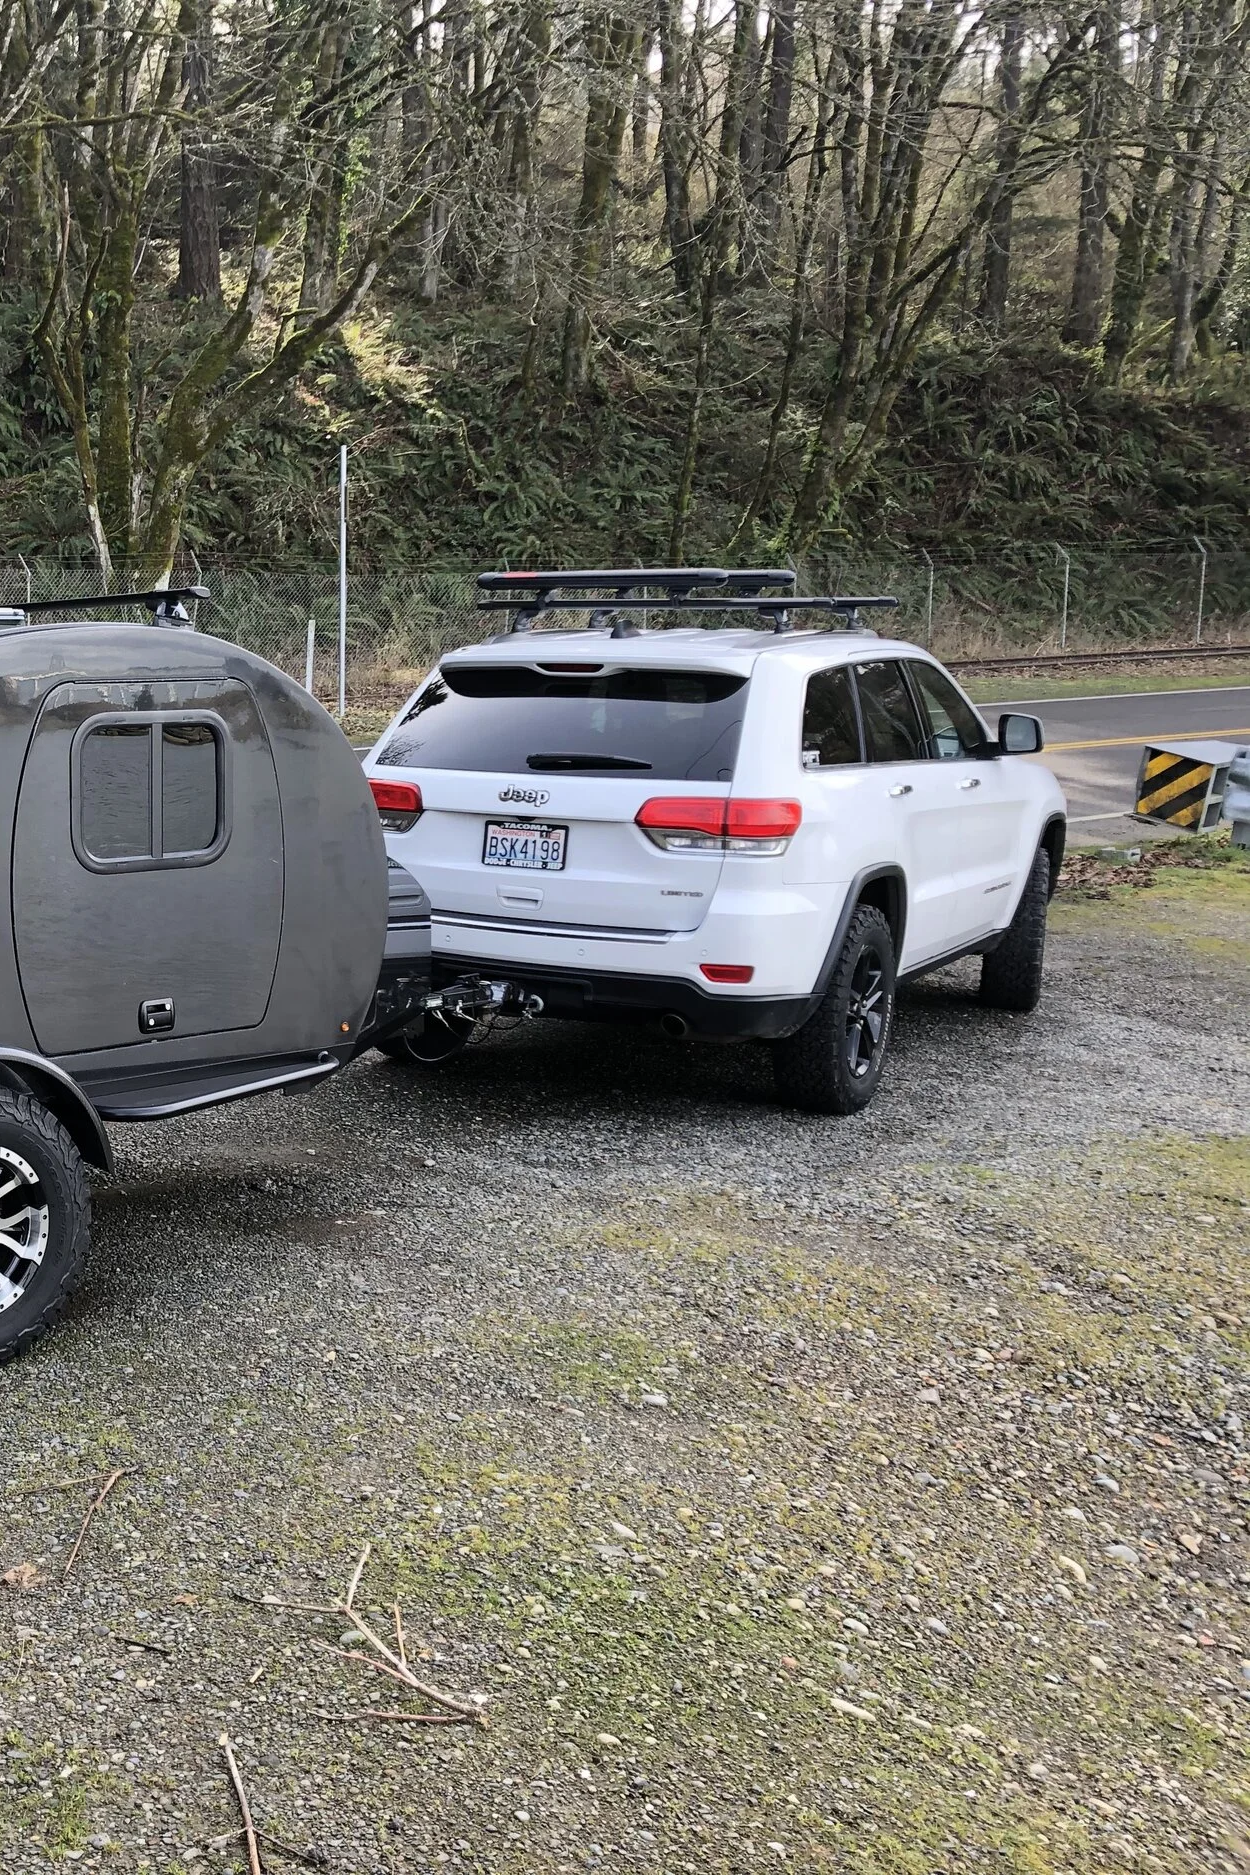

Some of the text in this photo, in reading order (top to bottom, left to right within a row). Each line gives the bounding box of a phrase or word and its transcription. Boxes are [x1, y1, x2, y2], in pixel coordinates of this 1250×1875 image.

[498, 784, 550, 807] Jeep
[503, 823, 548, 831] TACOMA
[492, 829, 536, 837] WASHINGTON
[489, 836, 560, 861] BSK4198
[510, 859, 543, 868] CHRYSLER
